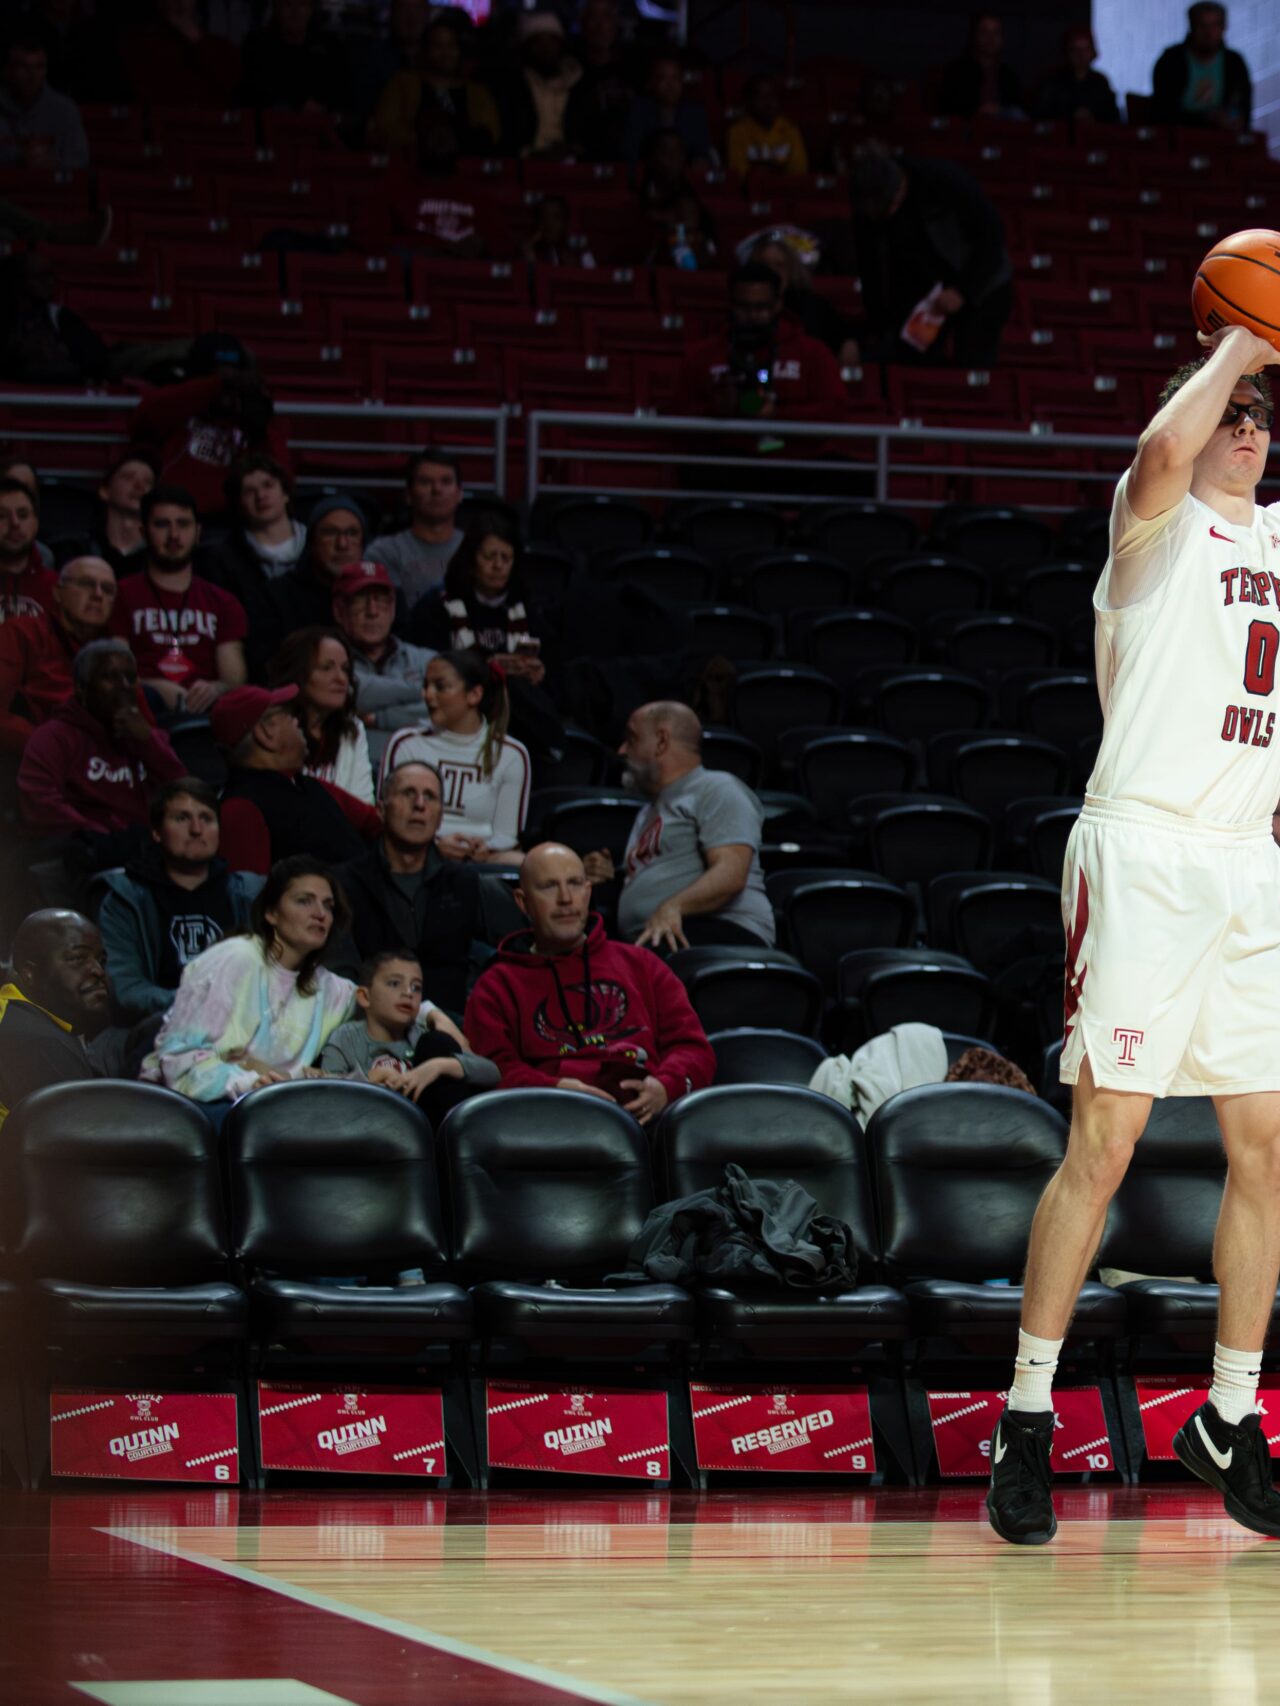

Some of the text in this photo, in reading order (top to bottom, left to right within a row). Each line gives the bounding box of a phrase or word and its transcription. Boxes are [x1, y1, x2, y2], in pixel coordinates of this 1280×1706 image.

[1243, 619, 1280, 697] 0
[1221, 704, 1276, 748] OWLS
[439, 759, 482, 816] T
[1112, 1027, 1145, 1067] T
[108, 1421, 181, 1457] QUINN
[316, 1415, 388, 1451] QUINN
[543, 1416, 613, 1451] QUINN
[731, 1409, 835, 1456] RESERVED
[214, 1464, 230, 1481] 6
[422, 1457, 436, 1473] 7
[646, 1460, 662, 1477] 8
[851, 1455, 867, 1470] 9
[1085, 1453, 1109, 1470] 10
